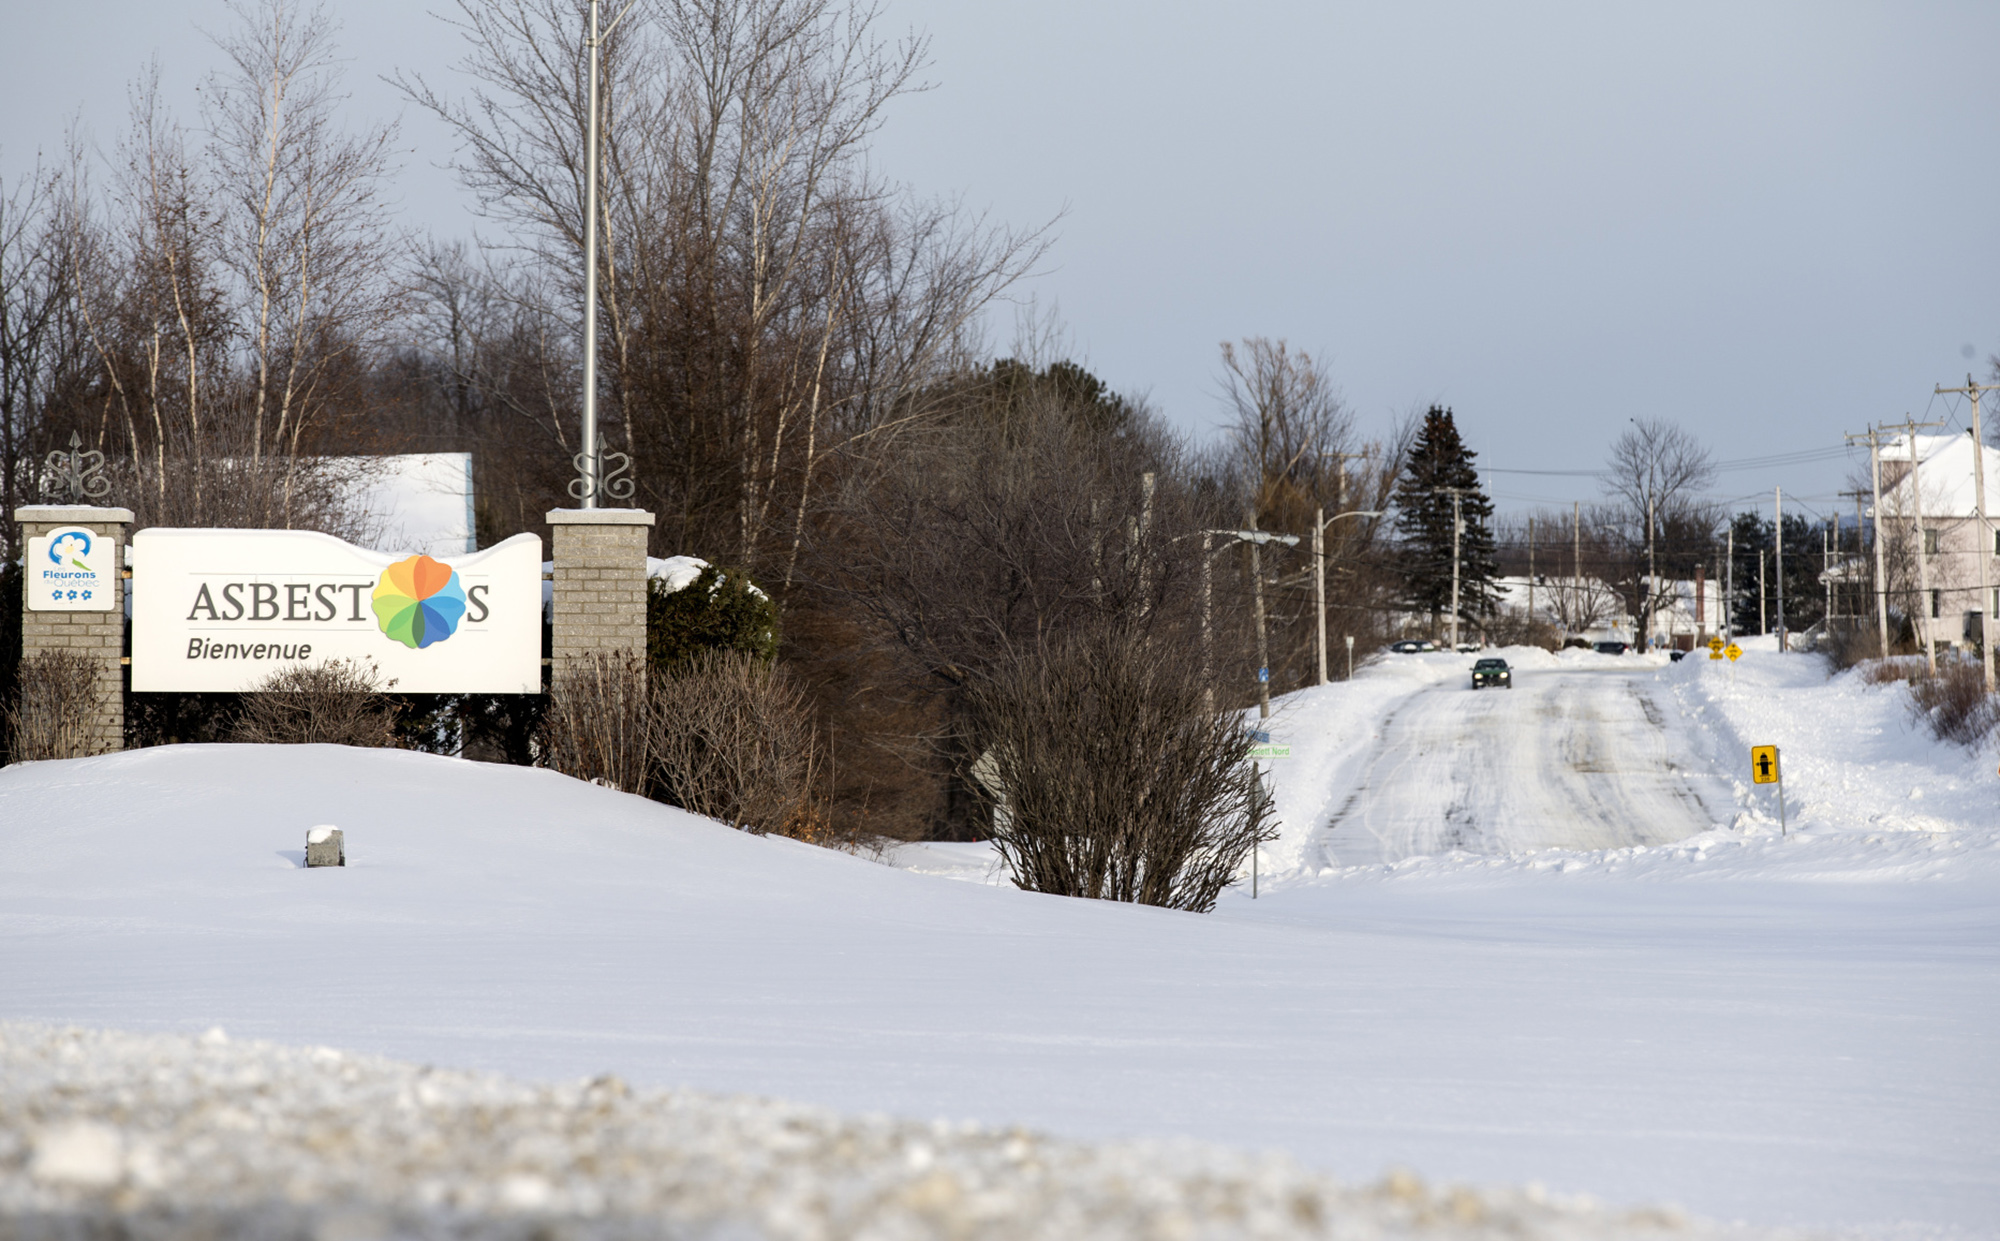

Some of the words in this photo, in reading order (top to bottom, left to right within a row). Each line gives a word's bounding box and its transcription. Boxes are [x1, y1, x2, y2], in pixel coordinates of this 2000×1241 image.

[43, 570, 96, 578] Fleurons
[54, 578, 100, 587] Québec
[186, 637, 312, 660] Bienvenue
[1246, 747, 1270, 756] slett
[1272, 747, 1290, 756] Nord
